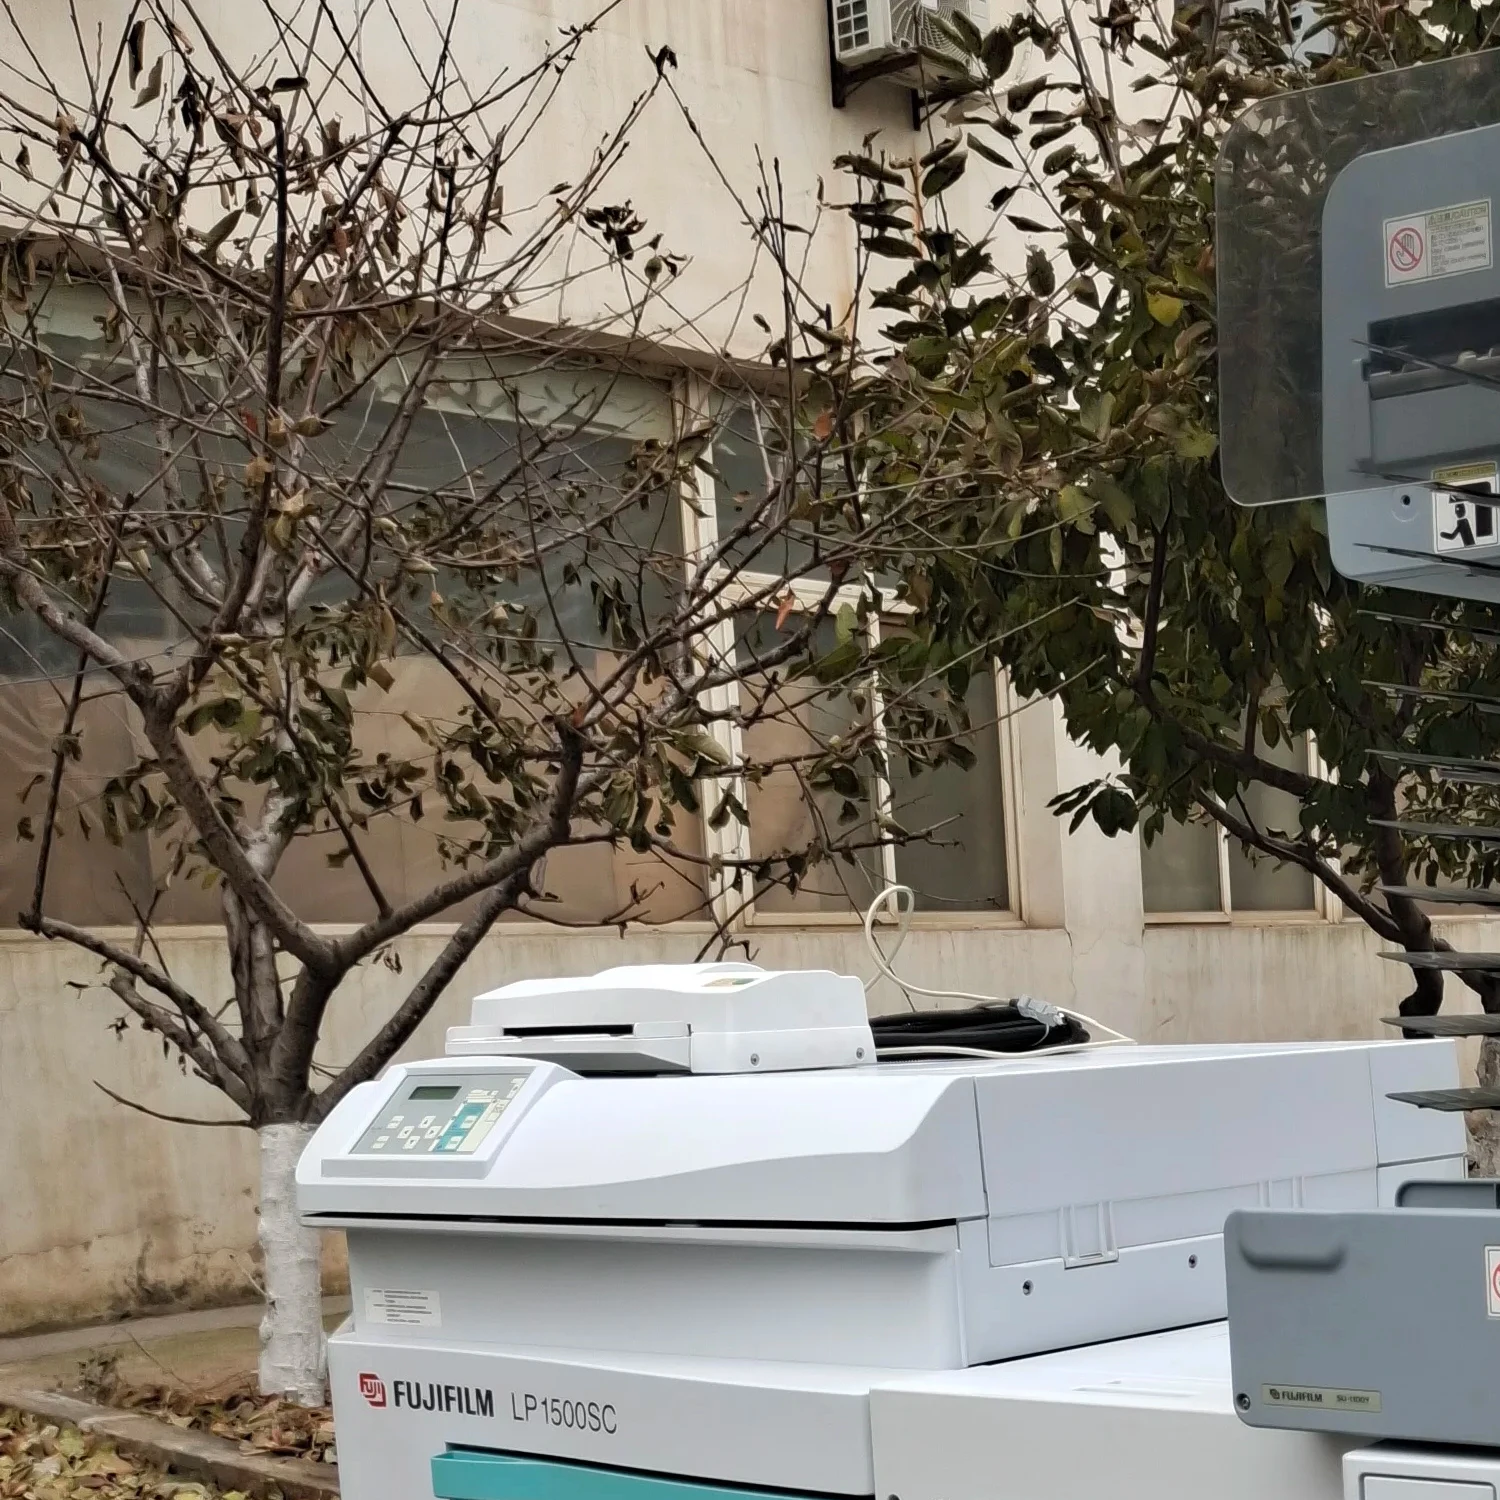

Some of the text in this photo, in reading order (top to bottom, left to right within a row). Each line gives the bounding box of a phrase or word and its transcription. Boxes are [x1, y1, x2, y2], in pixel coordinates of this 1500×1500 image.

[393, 1380, 494, 1417] FUJIFILM
[511, 1392, 617, 1434] LP1500SC
[1282, 1391, 1322, 1403] FUJIFILM
